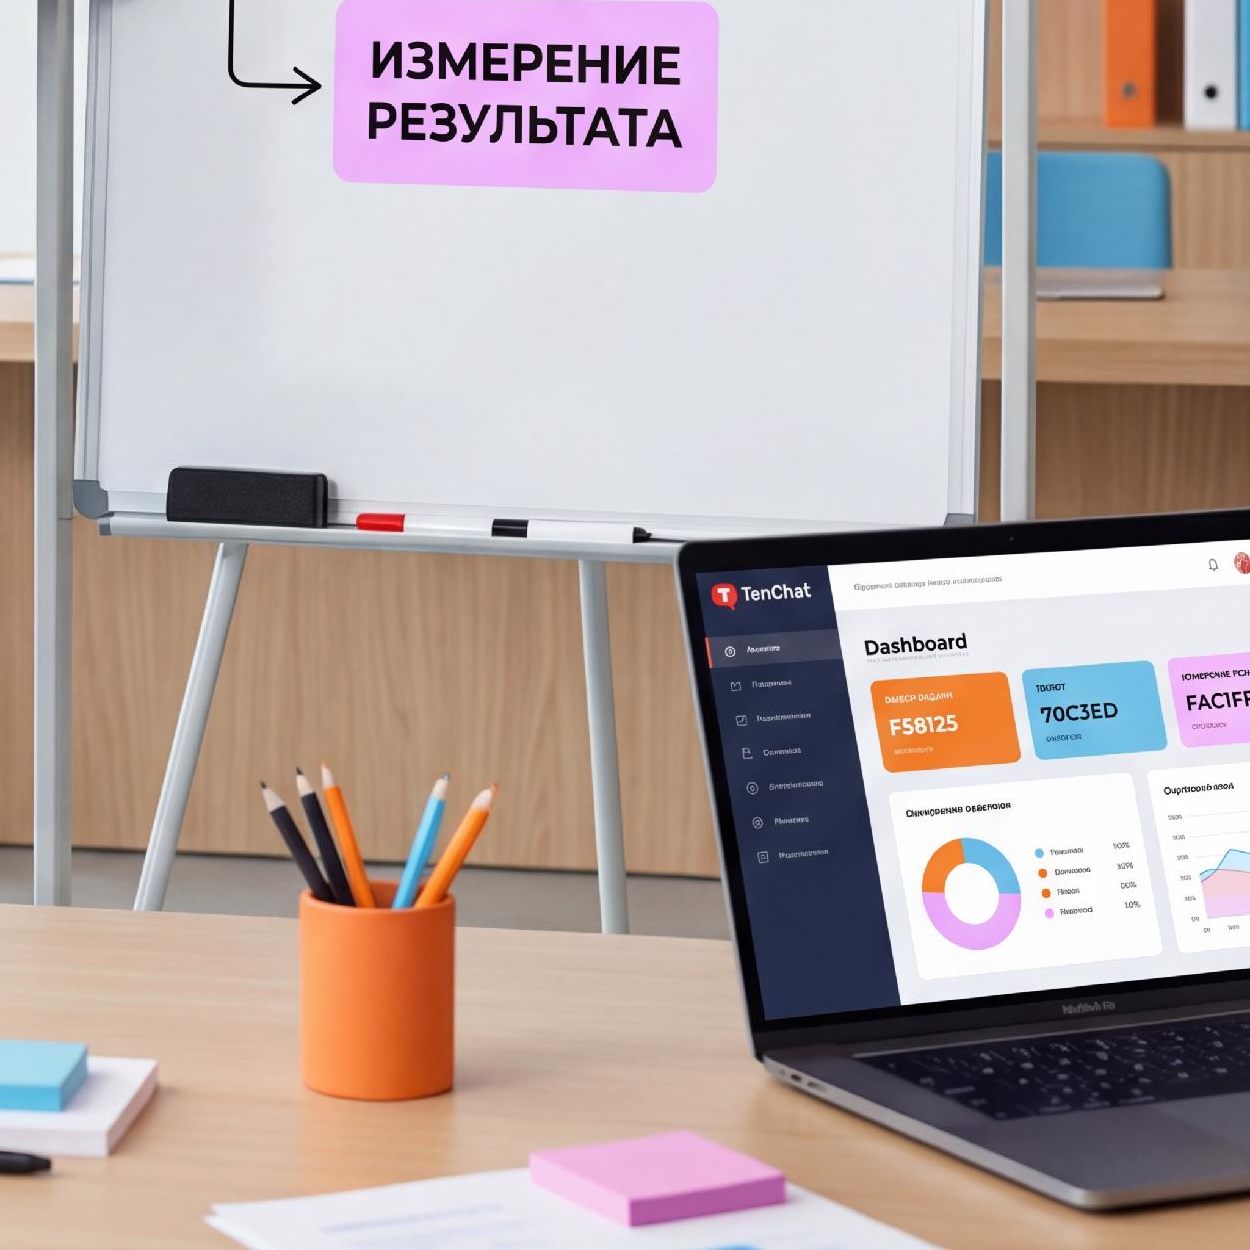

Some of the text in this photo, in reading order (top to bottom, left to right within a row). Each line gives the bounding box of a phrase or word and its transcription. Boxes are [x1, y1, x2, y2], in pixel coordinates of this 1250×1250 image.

[371, 40, 681, 85] ИЗМЕРЕНИЕ
[367, 101, 683, 148] РЕЗУЛЬТАТА
[741, 582, 812, 601] TenChat
[864, 633, 968, 656] Dashboard
[1040, 702, 1119, 723] 70C3ED
[889, 714, 959, 736] F58125
